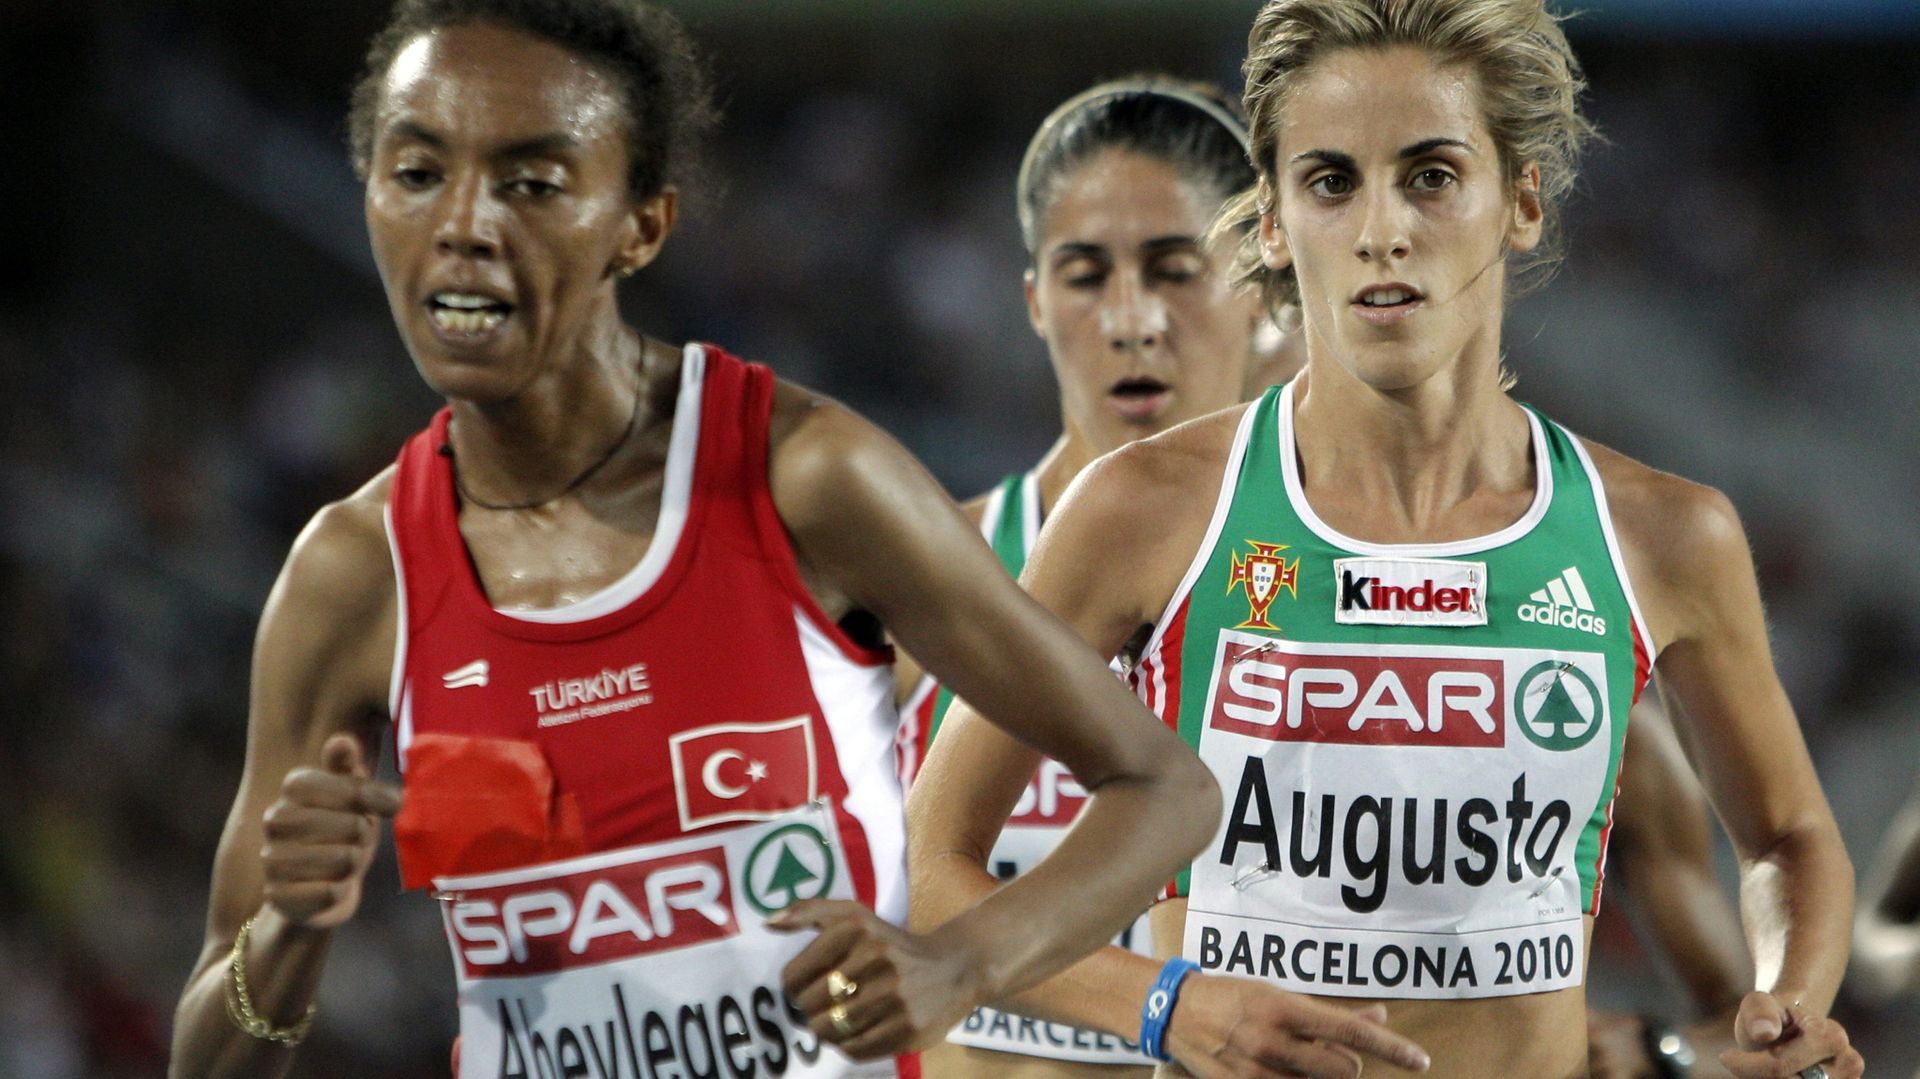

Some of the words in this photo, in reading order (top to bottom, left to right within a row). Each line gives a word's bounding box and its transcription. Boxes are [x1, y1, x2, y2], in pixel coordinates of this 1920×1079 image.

[1341, 570, 1478, 613] Kinder
[1516, 603, 1606, 636] adidas
[1222, 661, 1497, 734] SPAR
[1219, 755, 1572, 913] Augusto
[451, 862, 728, 965] SPAR
[1200, 926, 1478, 988] BARCELONA
[1494, 933, 1574, 986] 2010
